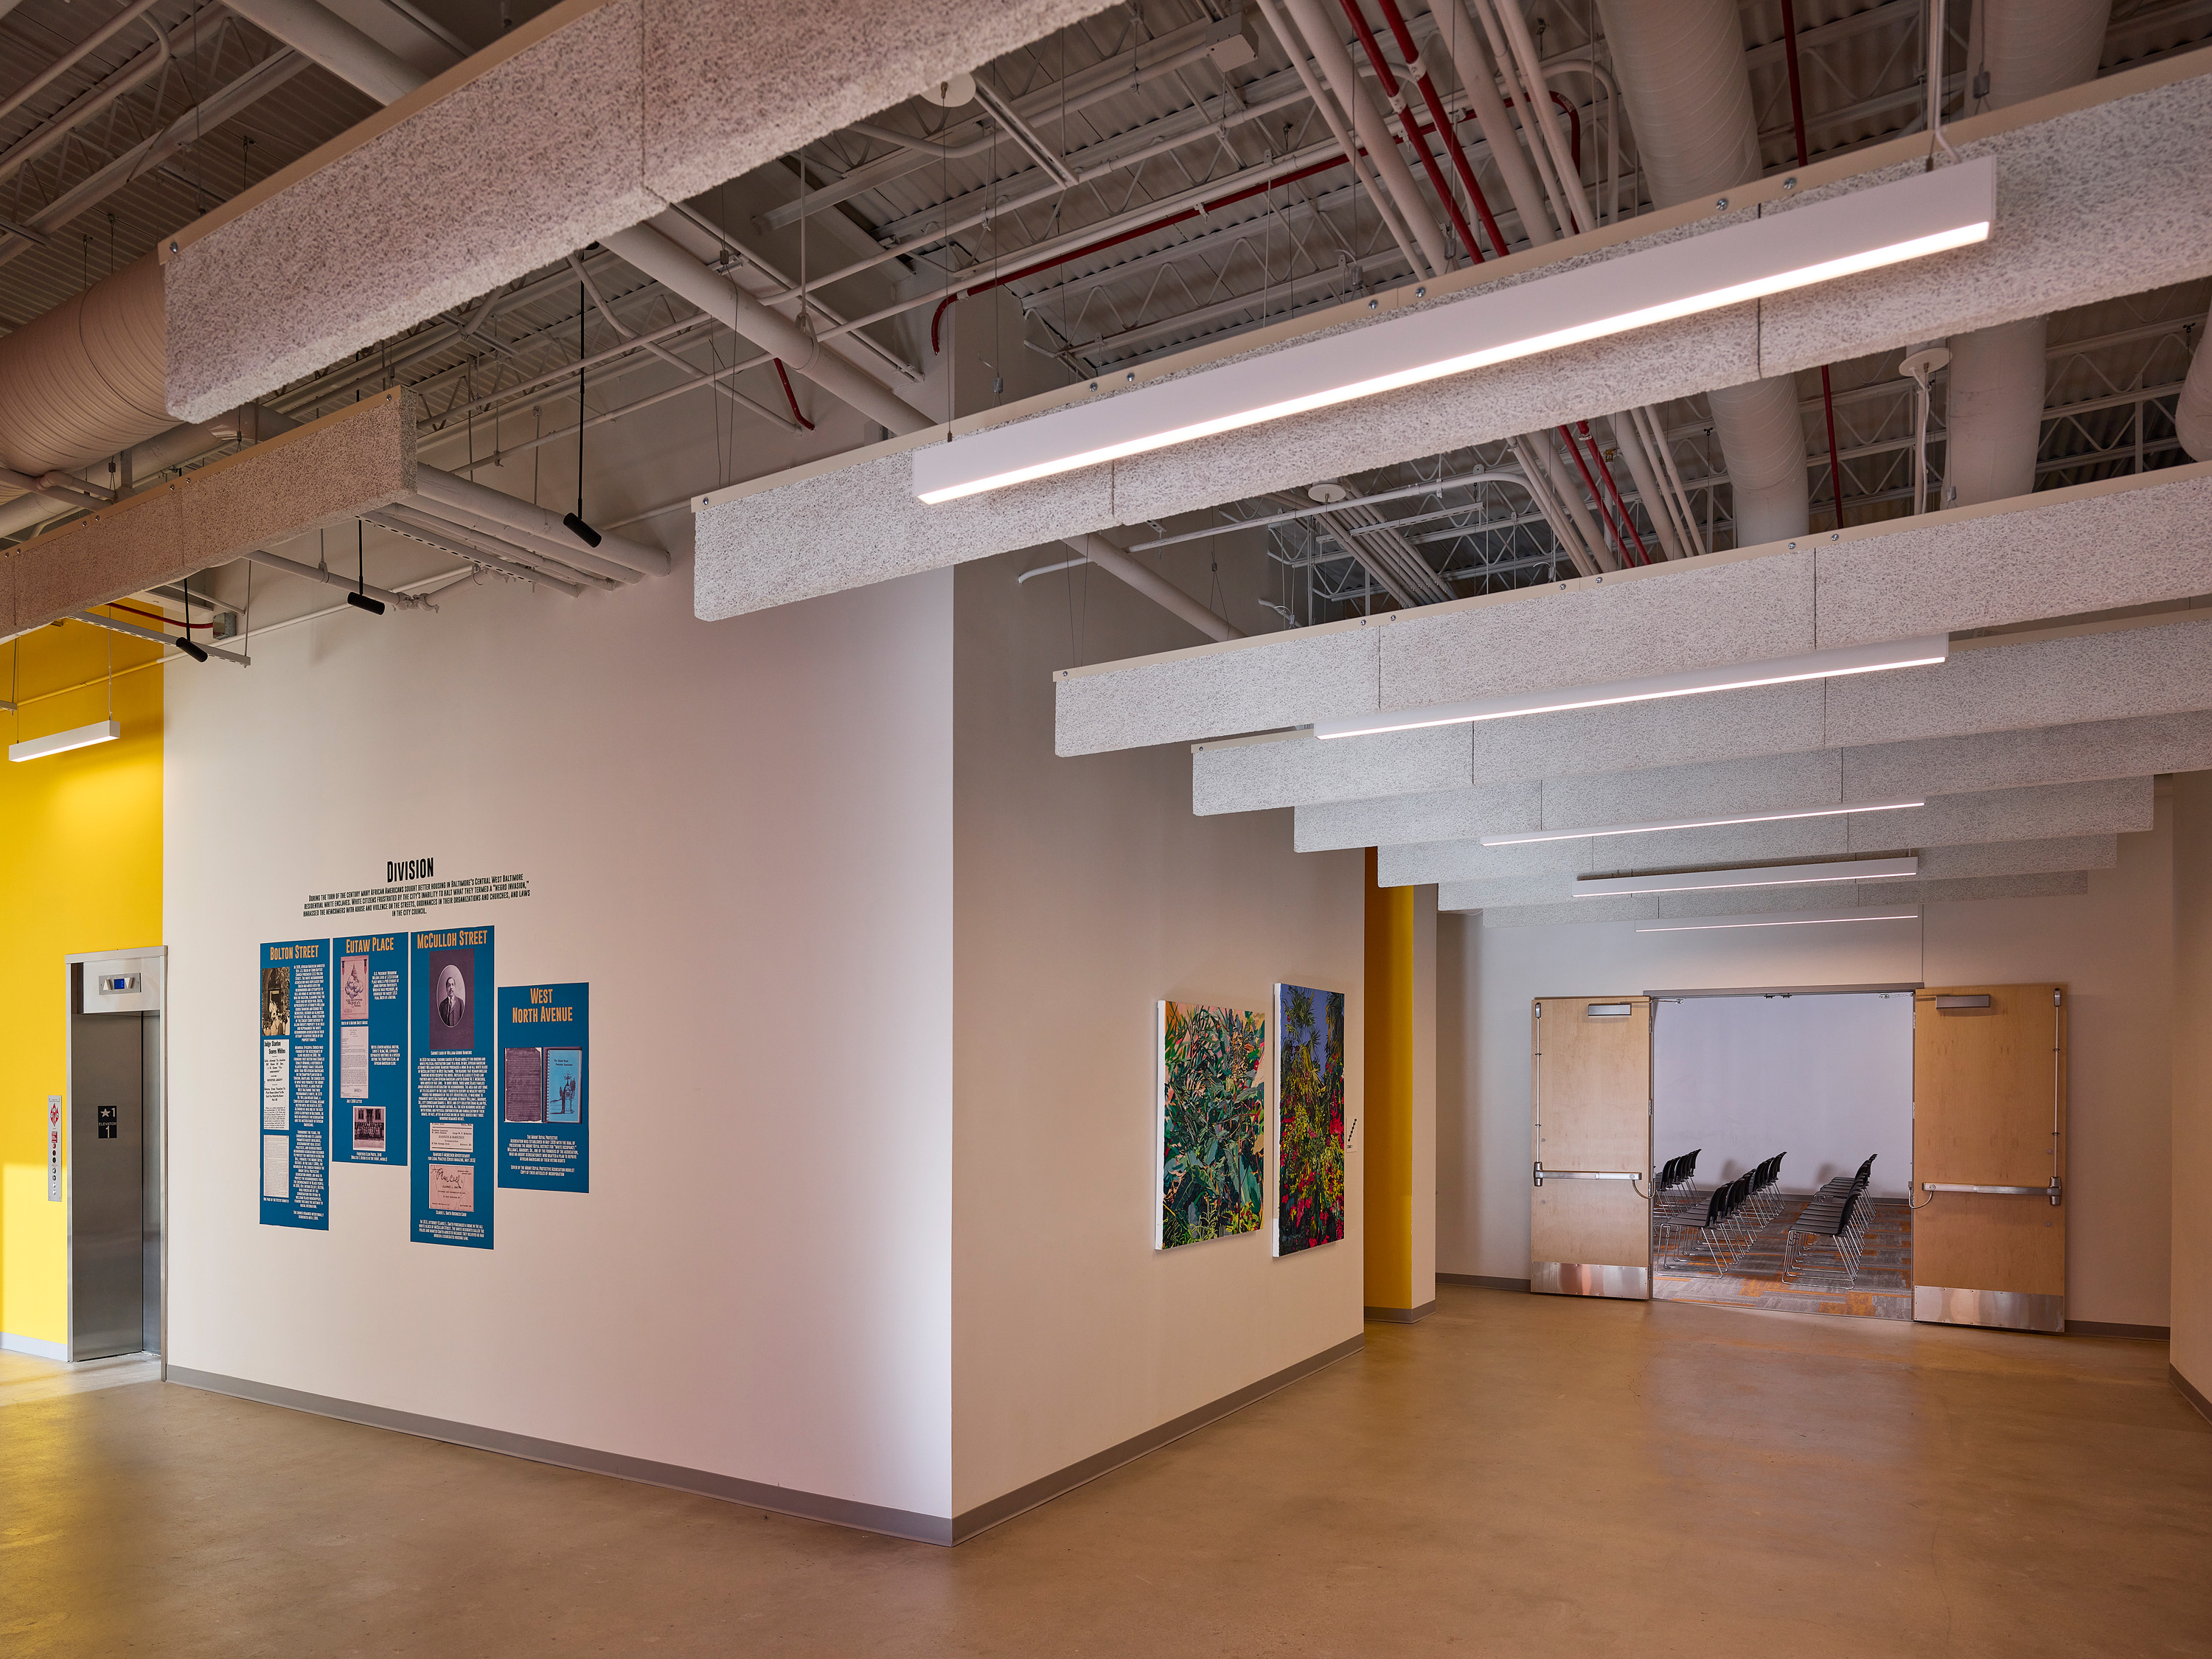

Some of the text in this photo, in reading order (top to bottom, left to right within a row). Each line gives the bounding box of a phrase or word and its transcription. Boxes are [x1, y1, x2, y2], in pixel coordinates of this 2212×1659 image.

[387, 858, 434, 883] DIVISION
[451, 879, 474, 888] BALTIMORE'S
[503, 874, 523, 883] BALTIMORE
[454, 895, 481, 903] ORGANIZATIONS
[346, 937, 394, 953] EUTAW PLACE
[459, 930, 487, 945] STREET
[270, 945, 319, 960] BOLTON STREET
[530, 988, 553, 1004] WEST
[512, 1006, 573, 1023] NORTH AVENUE
[106, 1126, 109, 1138] 1
